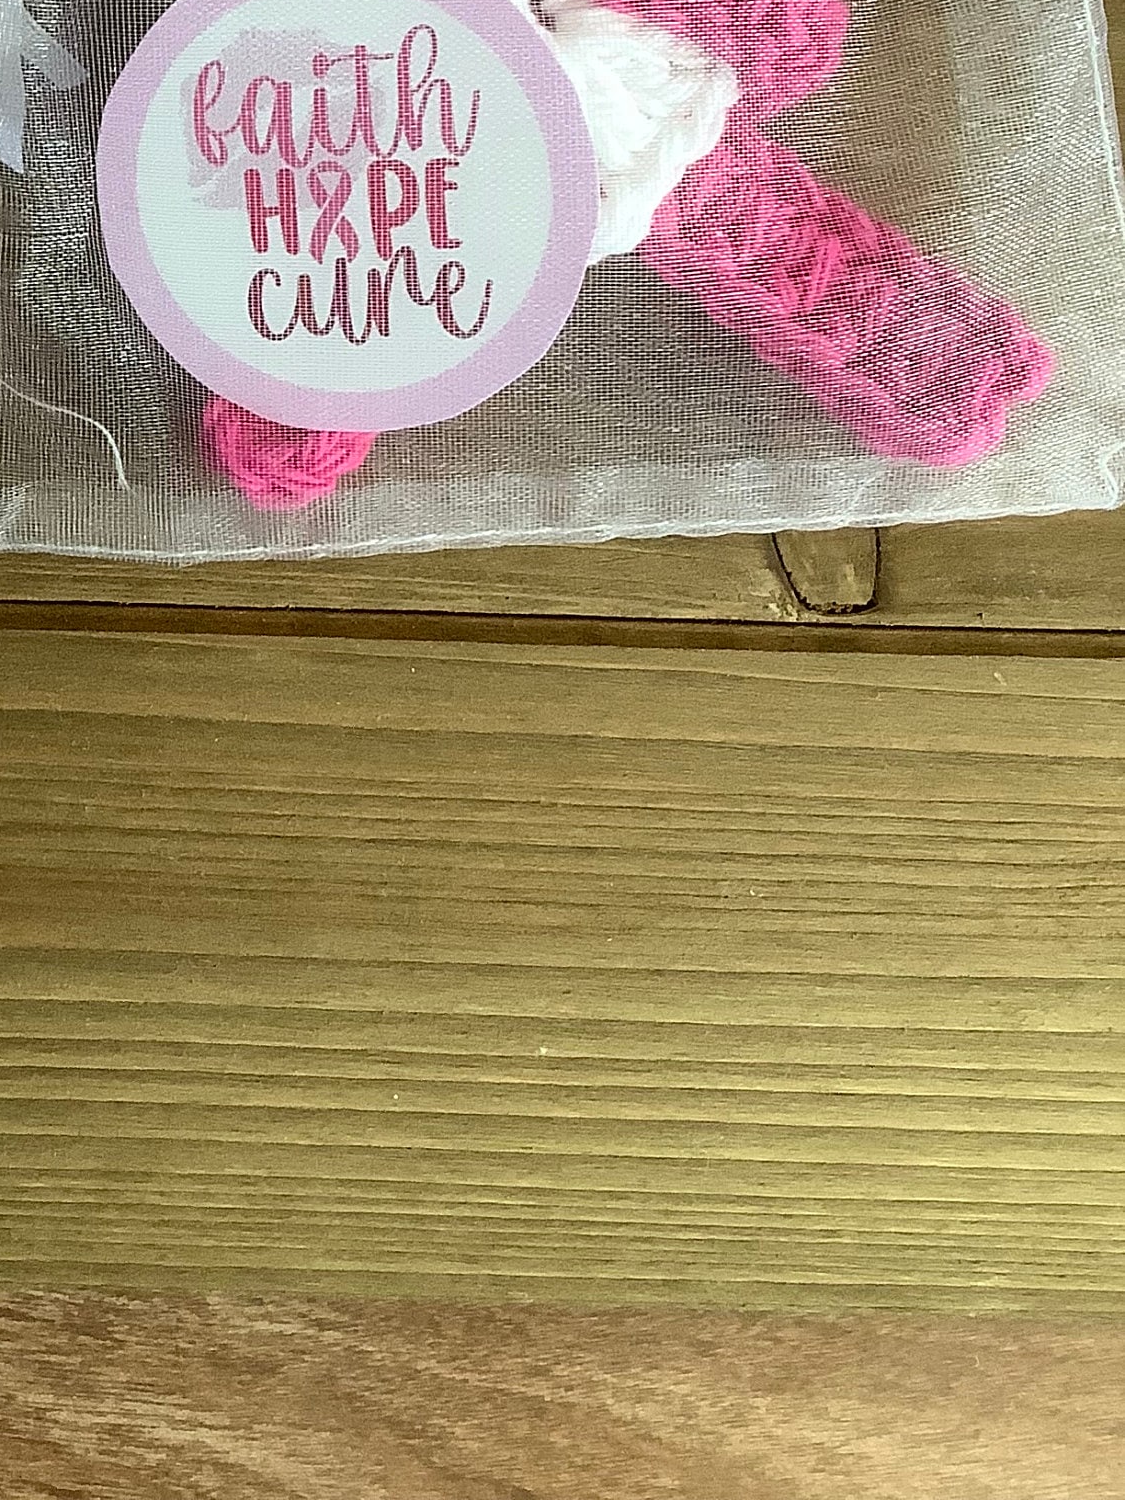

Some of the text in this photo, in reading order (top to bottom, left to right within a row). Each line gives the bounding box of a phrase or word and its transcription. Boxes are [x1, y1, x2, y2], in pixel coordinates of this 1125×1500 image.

[193, 24, 480, 167] faith
[243, 158, 463, 264] HOPE
[248, 246, 493, 345] cure
